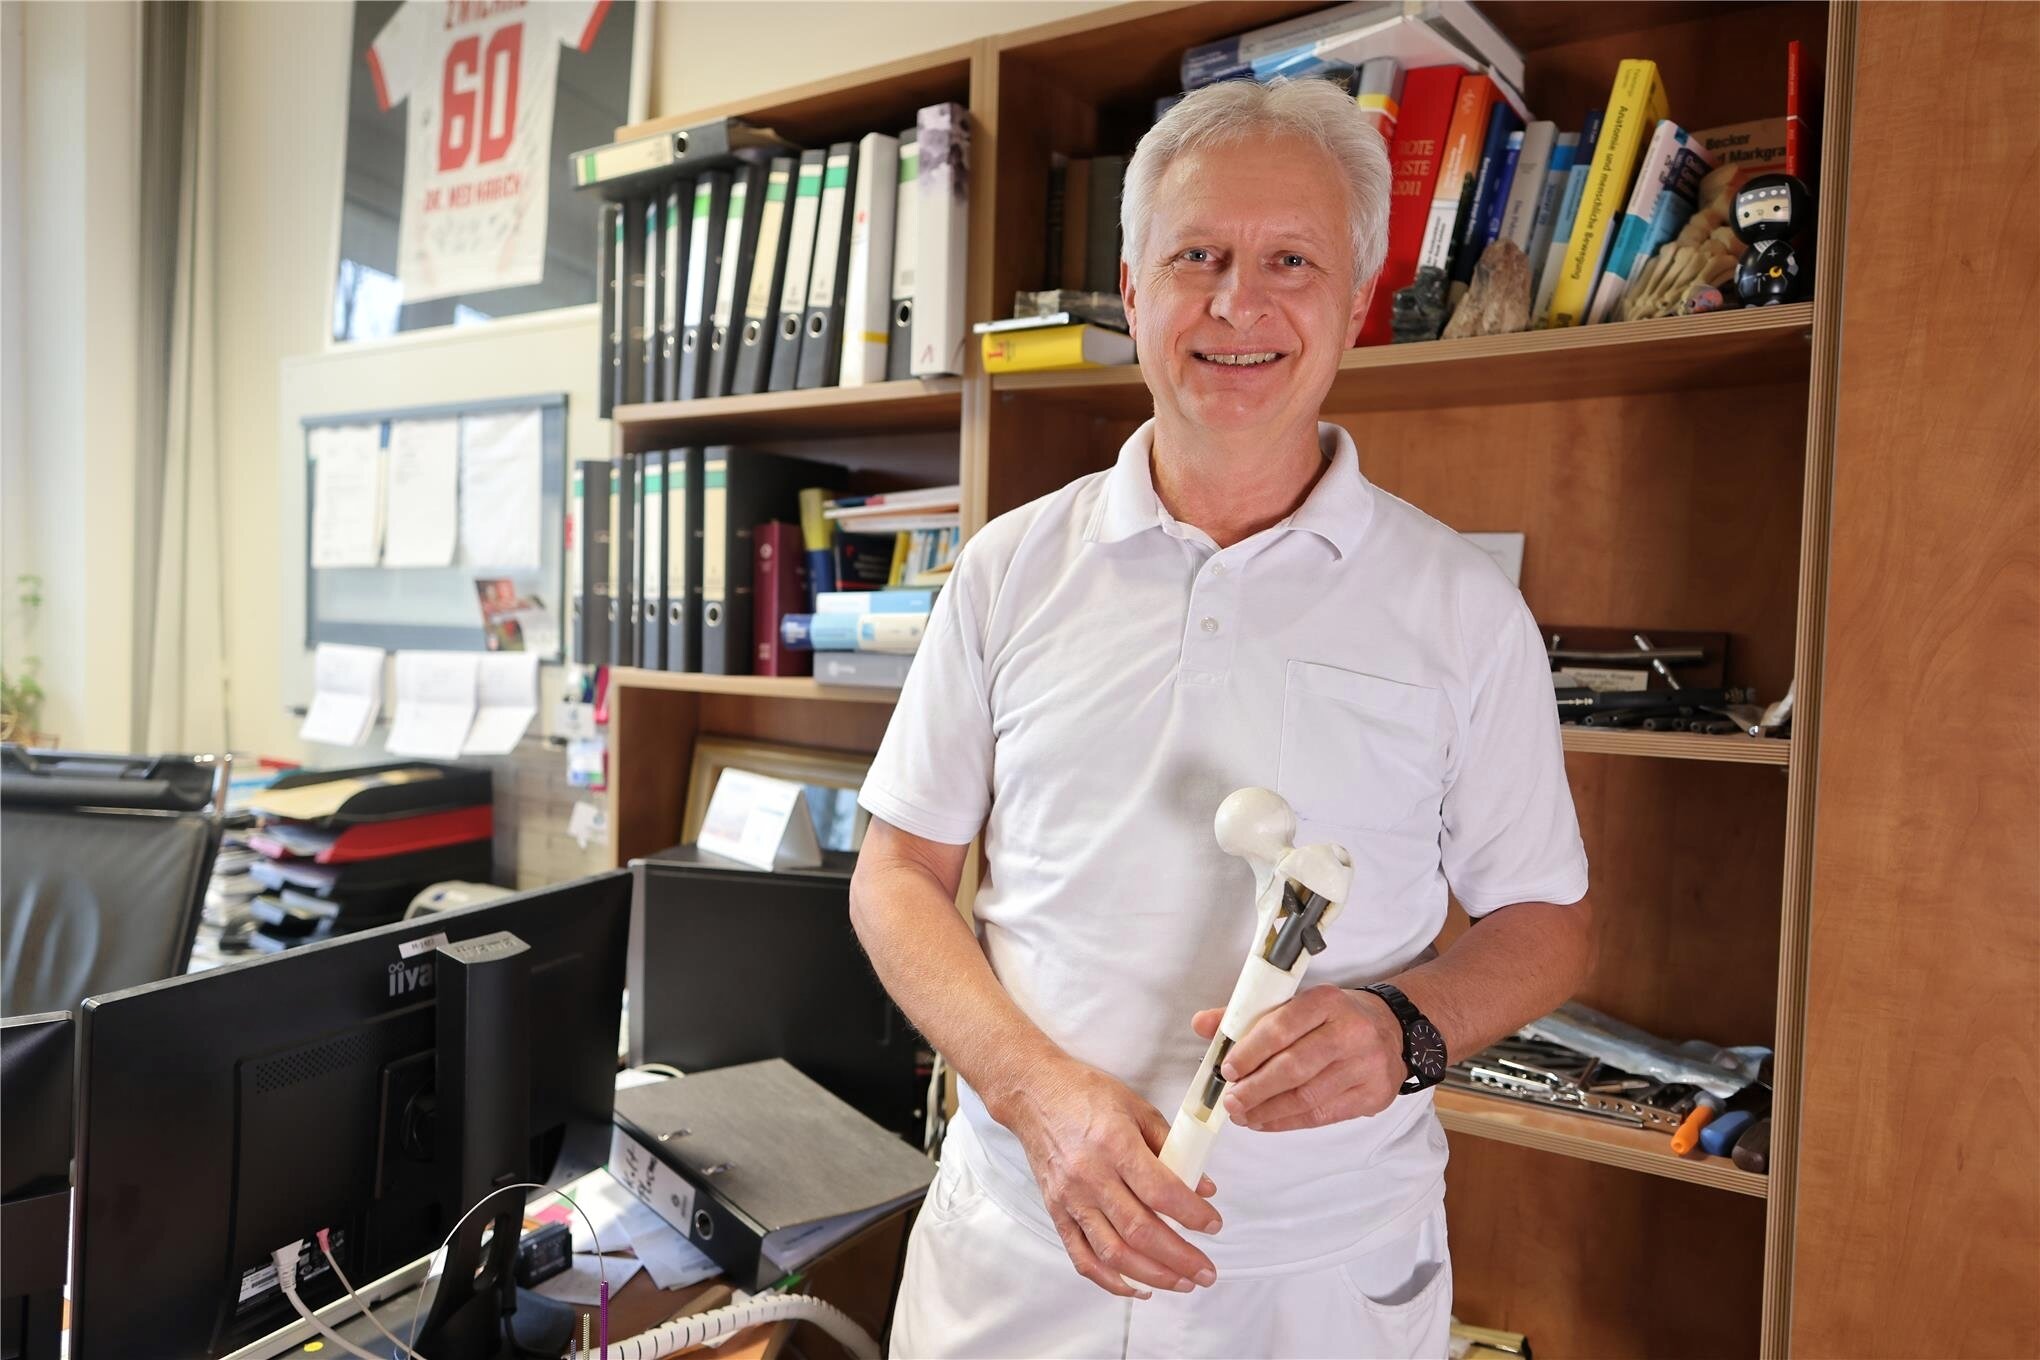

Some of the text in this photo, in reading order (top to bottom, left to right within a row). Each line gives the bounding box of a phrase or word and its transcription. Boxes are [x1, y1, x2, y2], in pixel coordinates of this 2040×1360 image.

[439, 22, 524, 172] 60
[1608, 105, 1629, 151] Anatomie
[1705, 134, 1751, 151] Becker
[1602, 152, 1614, 172] und
[1729, 146, 1787, 162] Markgra
[1587, 173, 1608, 230] menschliche
[1570, 231, 1594, 280] Bewegung
[388, 961, 434, 997] iiya
